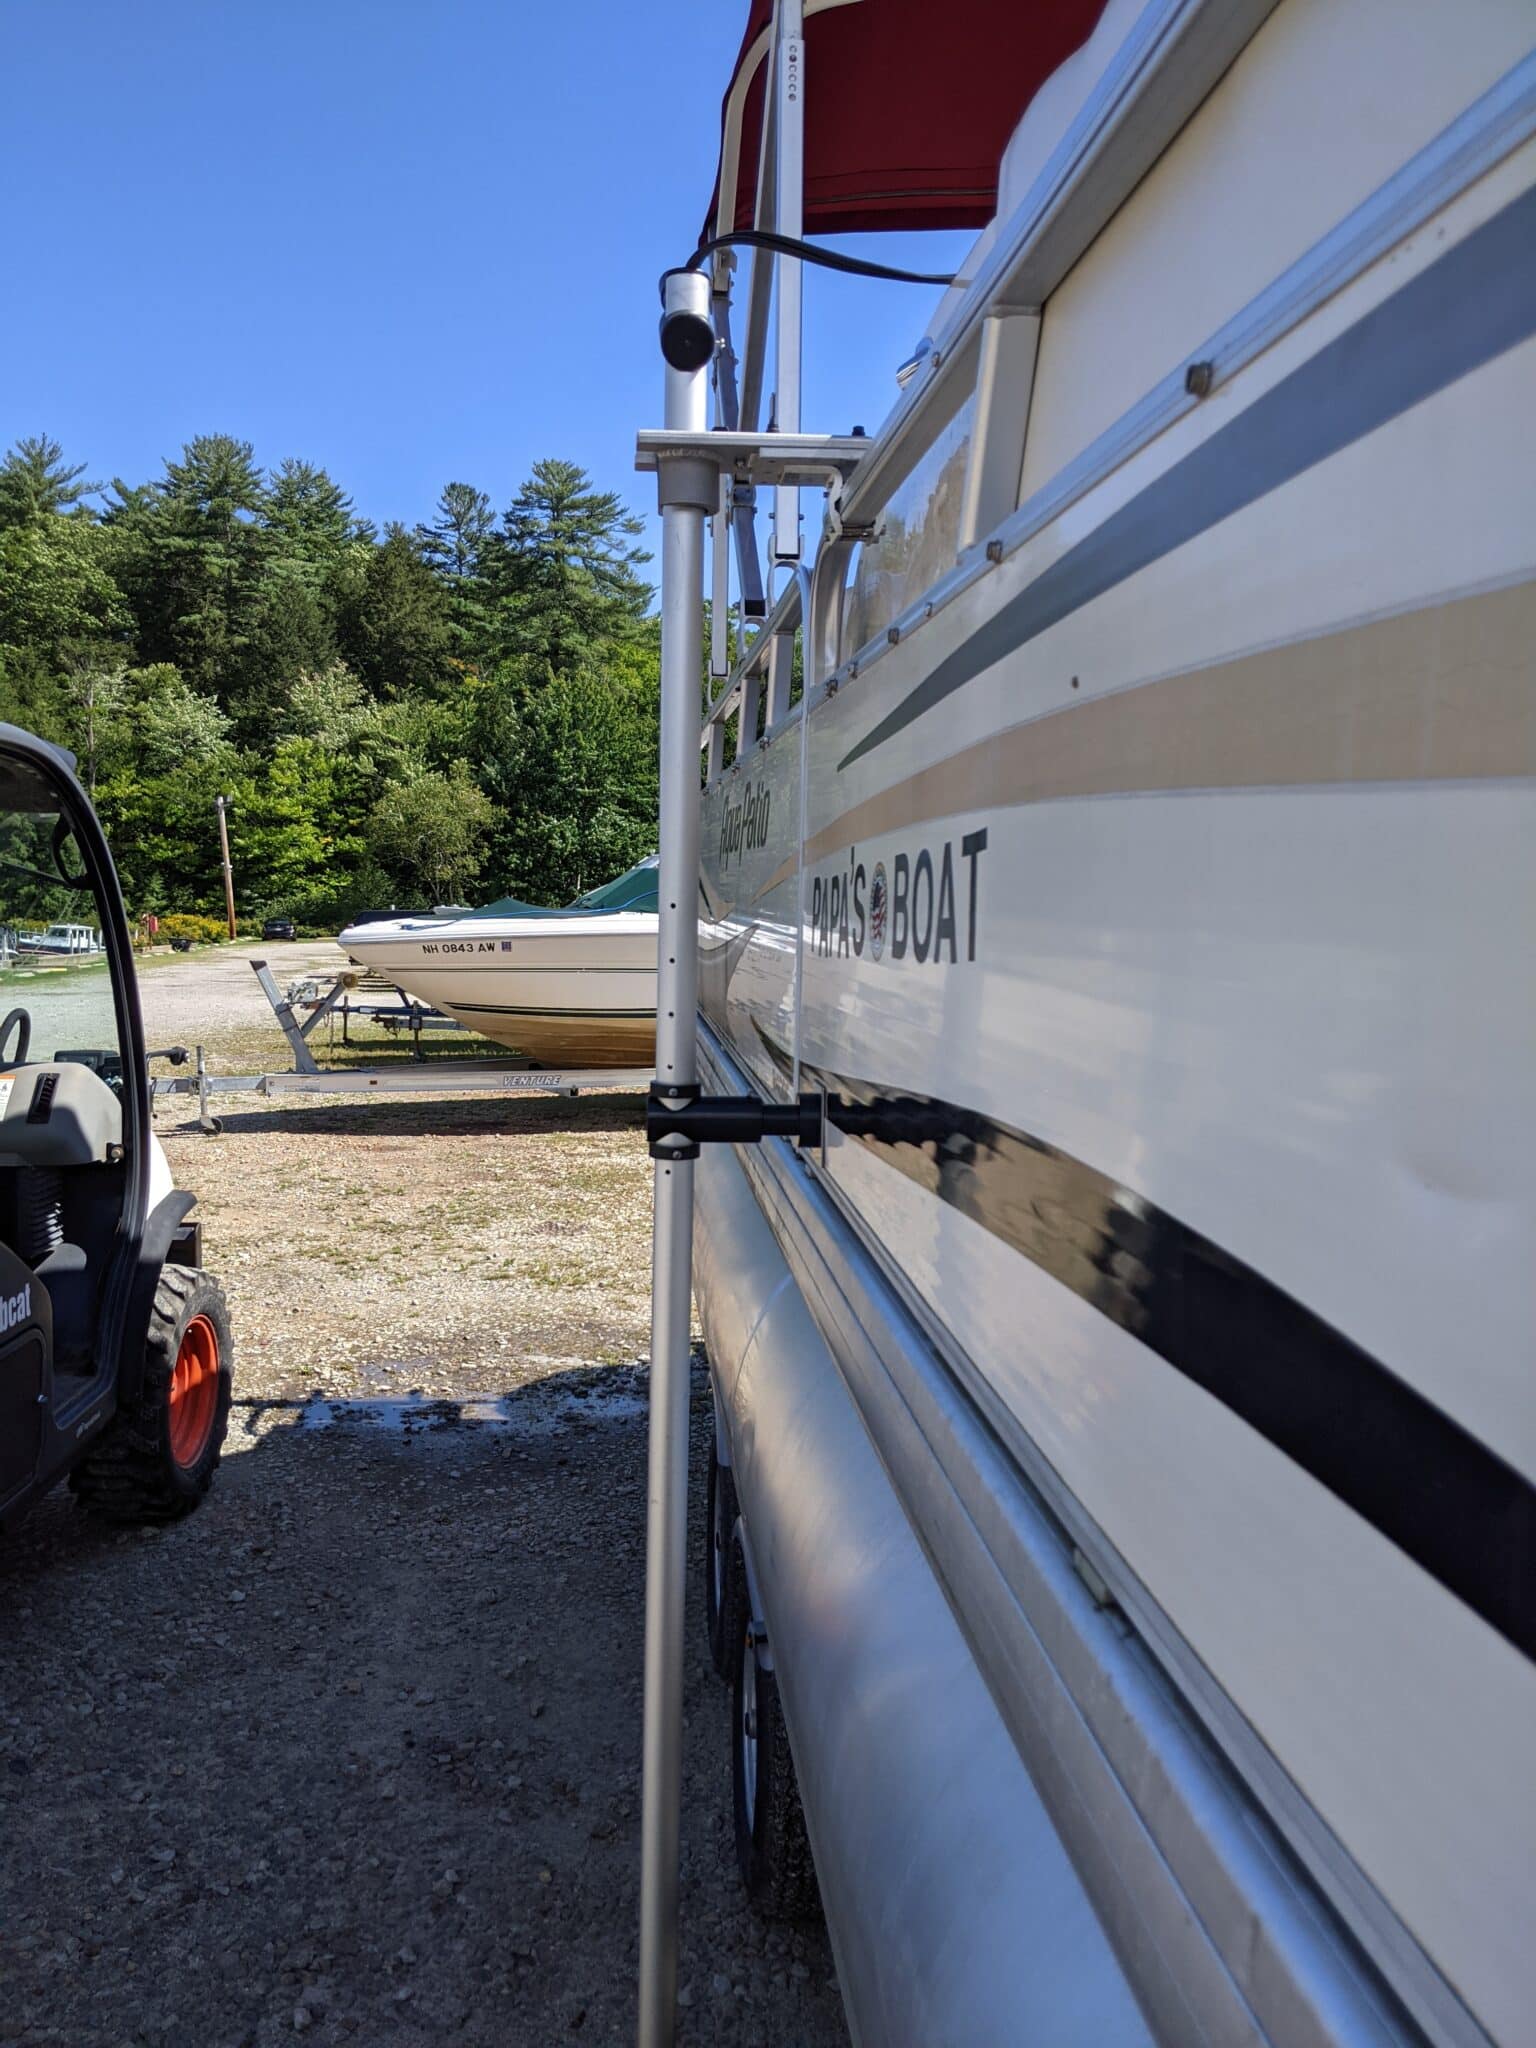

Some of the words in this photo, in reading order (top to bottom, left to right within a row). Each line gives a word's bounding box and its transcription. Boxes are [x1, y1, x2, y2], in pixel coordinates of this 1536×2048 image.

[811, 846, 866, 959] PAPA'S
[891, 827, 988, 964] BOAT
[422, 944, 439, 954] NH
[442, 943, 474, 953] 0843
[478, 942, 495, 953] AW
[503, 1075, 561, 1088] VENTURE
